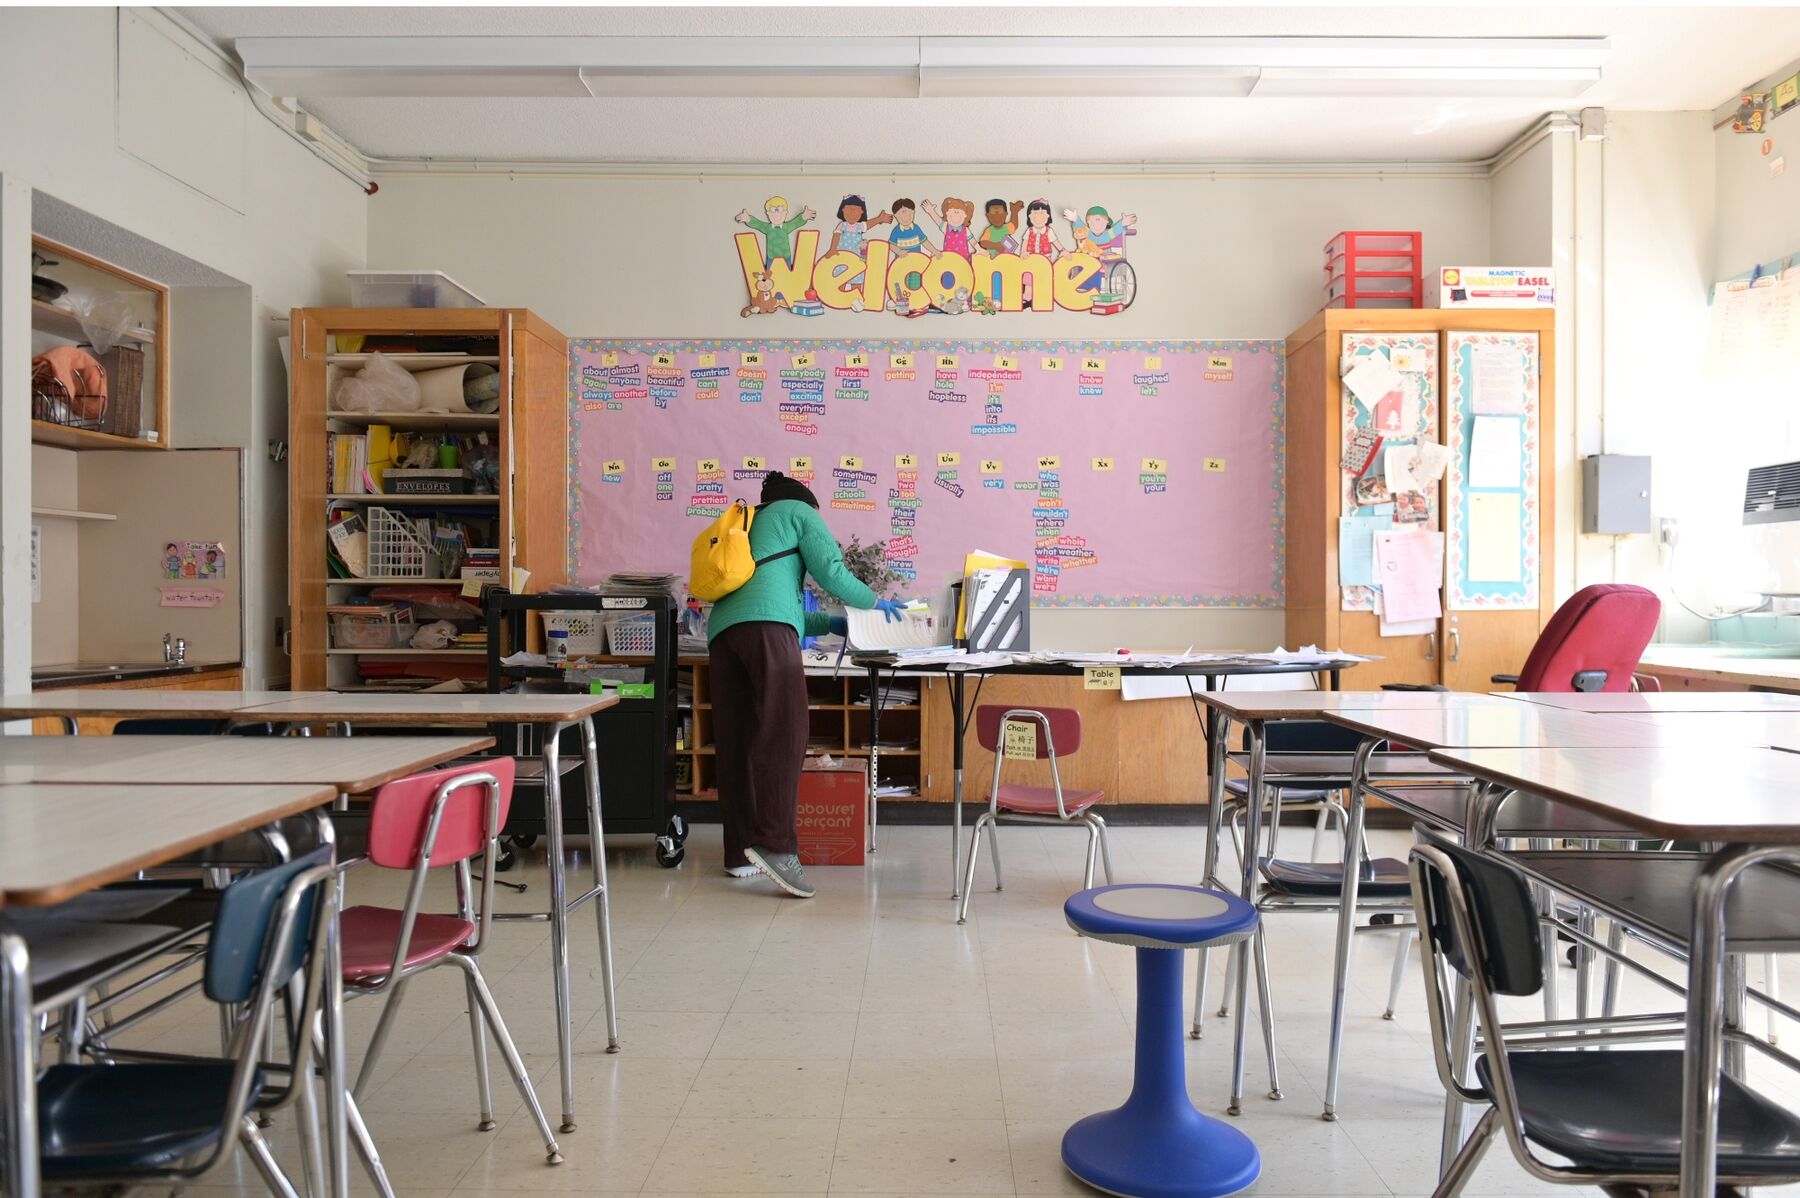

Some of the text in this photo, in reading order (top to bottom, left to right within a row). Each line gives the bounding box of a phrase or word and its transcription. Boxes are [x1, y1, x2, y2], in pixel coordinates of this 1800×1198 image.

[734, 229, 1102, 312] Welcome
[1517, 277, 1550, 286] EASEL
[658, 356, 669, 364] Bb
[746, 355, 758, 363] Dd
[797, 357, 808, 365] Ee
[941, 358, 953, 366] Hh
[1047, 360, 1056, 368] Jj
[583, 365, 639, 376] about almost
[647, 368, 682, 376] because
[691, 368, 730, 378] countries
[780, 369, 825, 379] everybody
[835, 368, 869, 377] favorite
[936, 371, 957, 379] have
[968, 370, 1021, 380] independent
[885, 371, 915, 381] getting
[1080, 375, 1103, 383] know
[1134, 374, 1169, 384] laughed
[1204, 372, 1233, 381] myself
[583, 376, 640, 389] again anyone
[647, 377, 684, 386] beautiful
[782, 380, 823, 391] especially
[843, 380, 860, 388] first
[935, 381, 954, 389] hole
[583, 390, 647, 401] always another
[650, 388, 677, 397] before
[697, 391, 719, 399] could
[835, 390, 869, 400] friendly
[1080, 387, 1103, 395] knew
[790, 392, 822, 402] exciting
[929, 391, 966, 402] hopeless
[585, 402, 602, 411] also
[655, 399, 666, 408] by
[779, 404, 824, 414] everything
[985, 405, 1002, 413] into
[780, 413, 808, 422] except
[785, 424, 817, 434] enough
[971, 425, 1016, 434] impossible
[703, 462, 714, 470] Pp
[747, 460, 759, 468] Qq
[1040, 458, 1055, 466] Ww
[1149, 461, 1159, 470] Yy
[658, 473, 672, 481] off
[697, 471, 725, 481] people
[789, 470, 814, 479] really
[833, 469, 876, 483] something
[897, 472, 917, 481] they
[938, 471, 957, 480] until
[1039, 472, 1057, 480] who
[1140, 474, 1166, 484] you're
[396, 481, 451, 492] ENVELOPES
[696, 484, 722, 493] pretty
[839, 480, 857, 488] said
[935, 479, 964, 497] usually
[984, 480, 1003, 489] very
[1015, 482, 1038, 490] wear
[1041, 481, 1059, 489] was
[1145, 484, 1165, 493] your
[834, 490, 865, 498] schools
[890, 490, 899, 498] to
[1040, 489, 1058, 498] with
[692, 496, 727, 506] prettiest
[888, 500, 922, 509] through
[1038, 499, 1062, 507] won't
[831, 501, 875, 511] sometimes
[894, 509, 914, 517] their
[1033, 509, 1068, 518] wouldn't
[891, 518, 915, 526] there
[1036, 519, 1064, 527] where
[892, 527, 912, 535] then
[1036, 528, 1060, 536] when
[187, 542, 202, 550] Take
[890, 536, 913, 548] that's
[1037, 537, 1085, 547] went whole
[885, 546, 918, 559] thought
[1036, 548, 1093, 557] what weather
[888, 560, 912, 568] threw
[1037, 556, 1097, 569] write whether
[1036, 575, 1057, 583] want
[1091, 670, 1114, 678] Table
[1006, 723, 1028, 733] Chair
[796, 803, 855, 815] abouret
